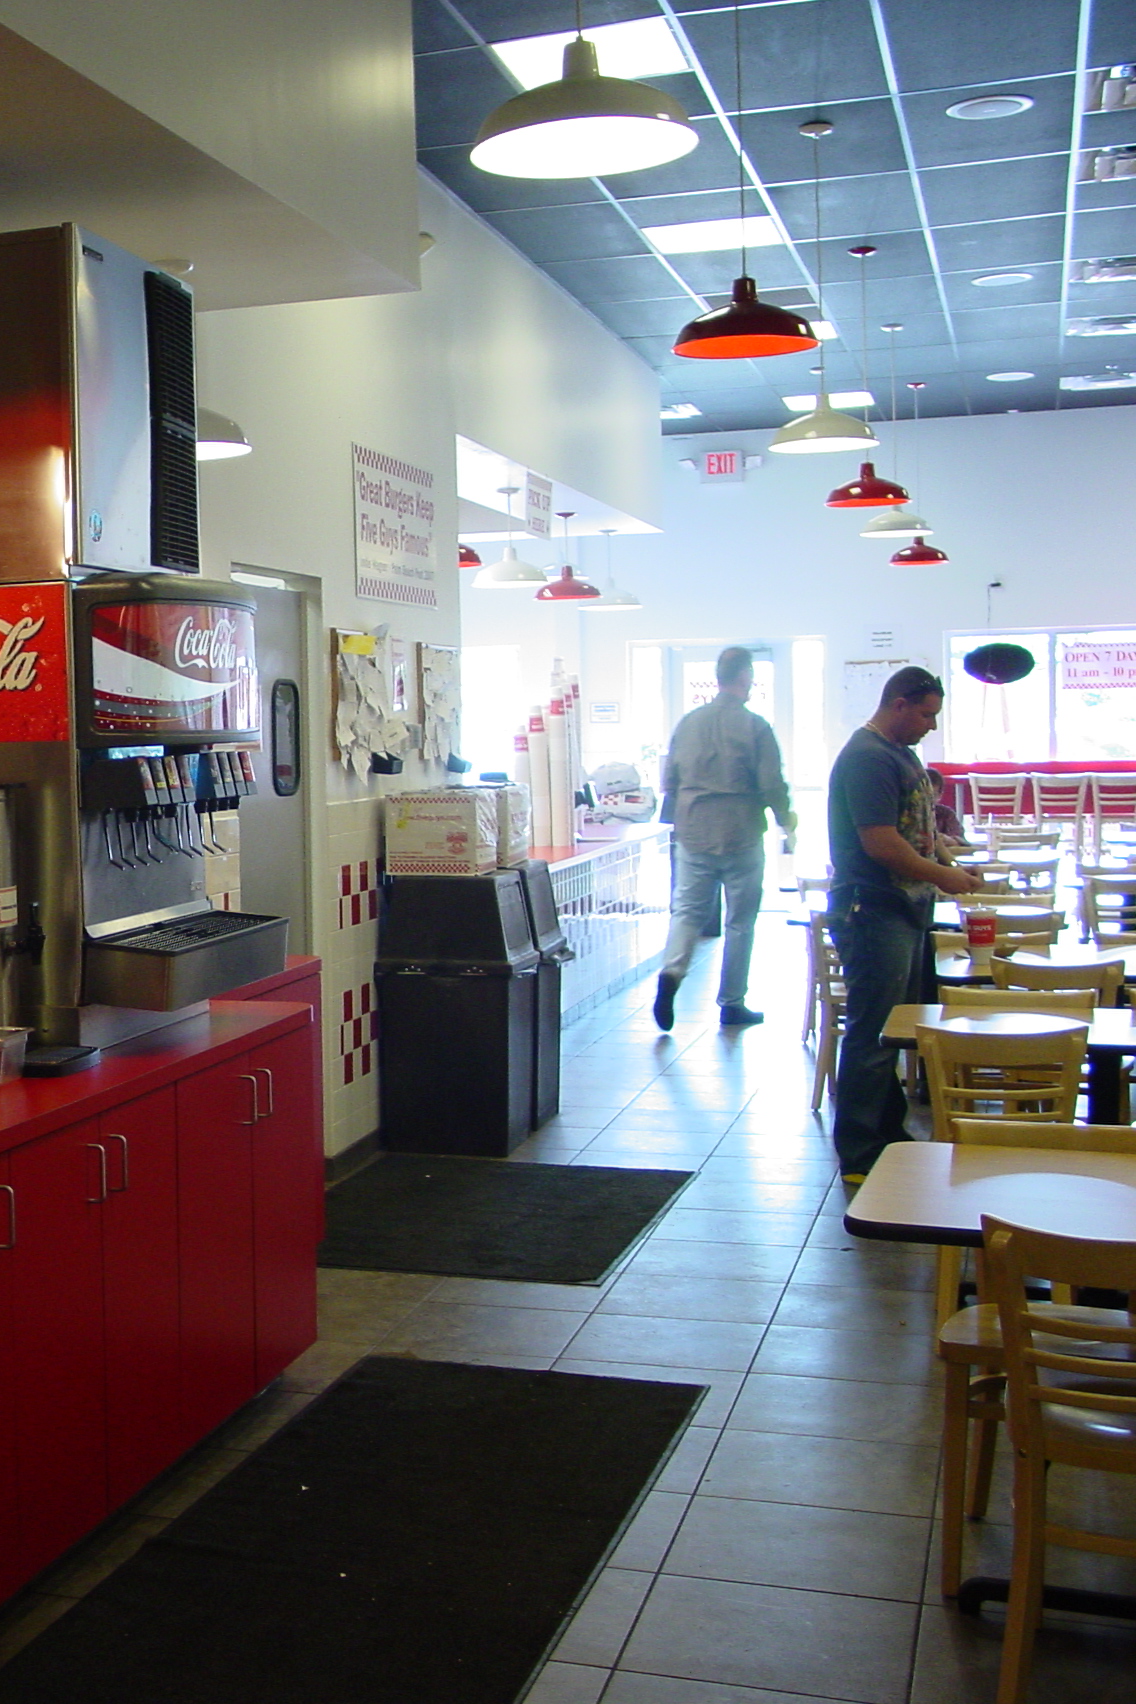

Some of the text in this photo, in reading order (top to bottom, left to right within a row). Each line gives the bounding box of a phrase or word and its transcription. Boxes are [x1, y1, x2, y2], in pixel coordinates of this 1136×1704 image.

[706, 453, 736, 474] EXIT
[384, 480, 414, 519] Burgers
[415, 490, 434, 527] Keep
[528, 488, 542, 508] PICK
[361, 513, 377, 544] Five
[379, 518, 399, 555] Guys
[175, 616, 238, 669] Coca-Cola
[1065, 652, 1100, 662] OPEN
[1105, 651, 1111, 662] 7
[1067, 668, 1077, 678] 11
[1082, 669, 1100, 677] am
[1113, 667, 1124, 677] 10
